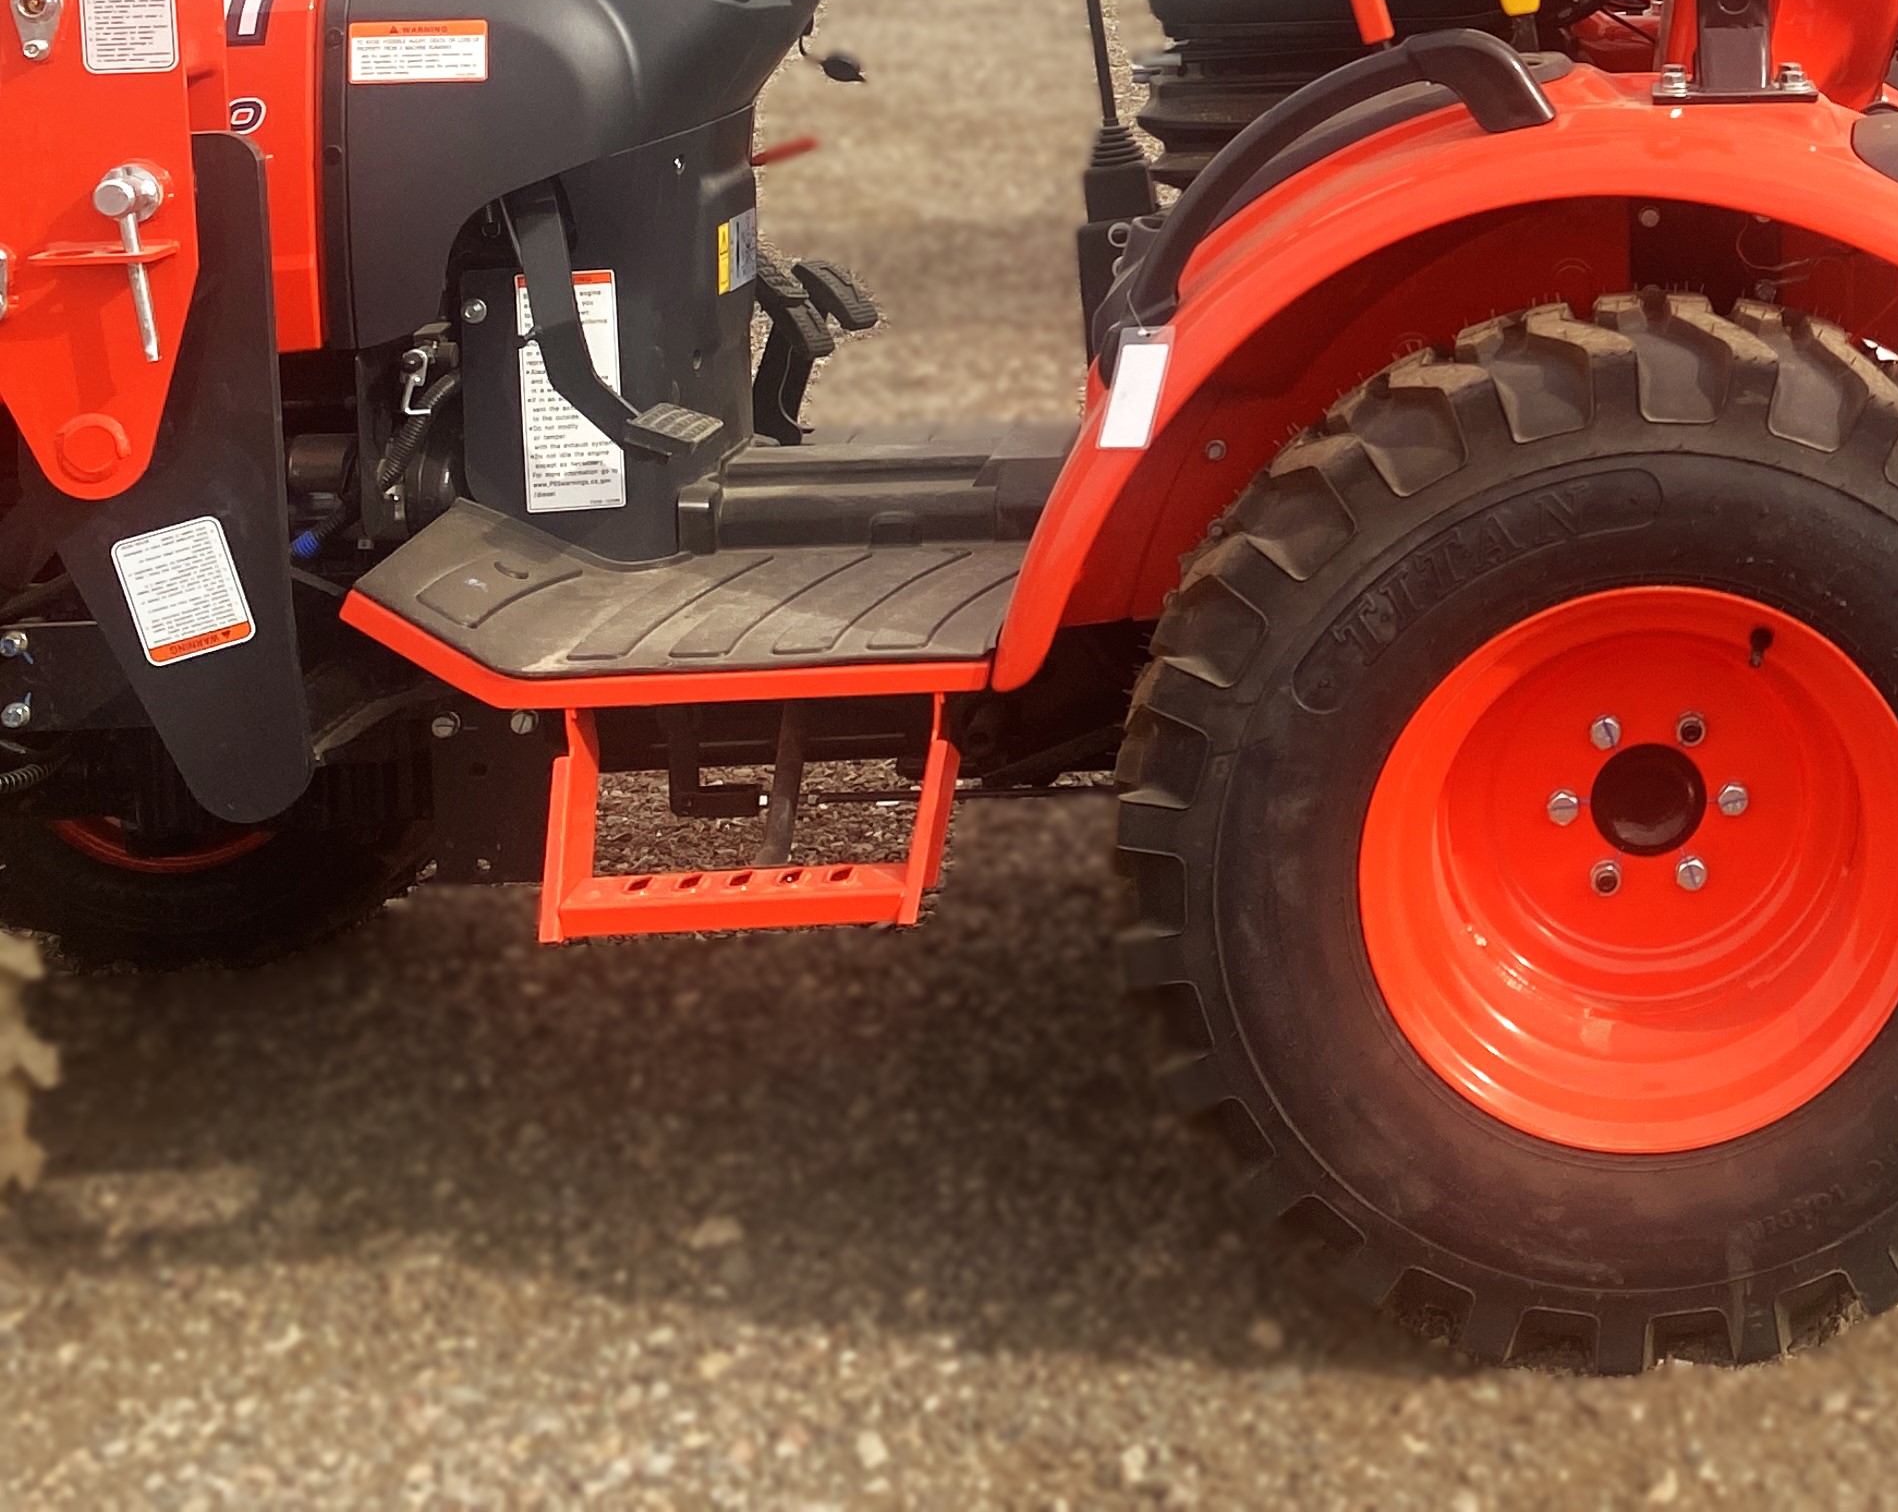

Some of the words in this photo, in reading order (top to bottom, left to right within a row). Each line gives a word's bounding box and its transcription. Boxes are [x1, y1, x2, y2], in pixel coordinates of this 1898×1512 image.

[402, 25, 448, 34] WARNING
[1332, 481, 1590, 668] TITAN
[169, 635, 218, 654] WARNING
